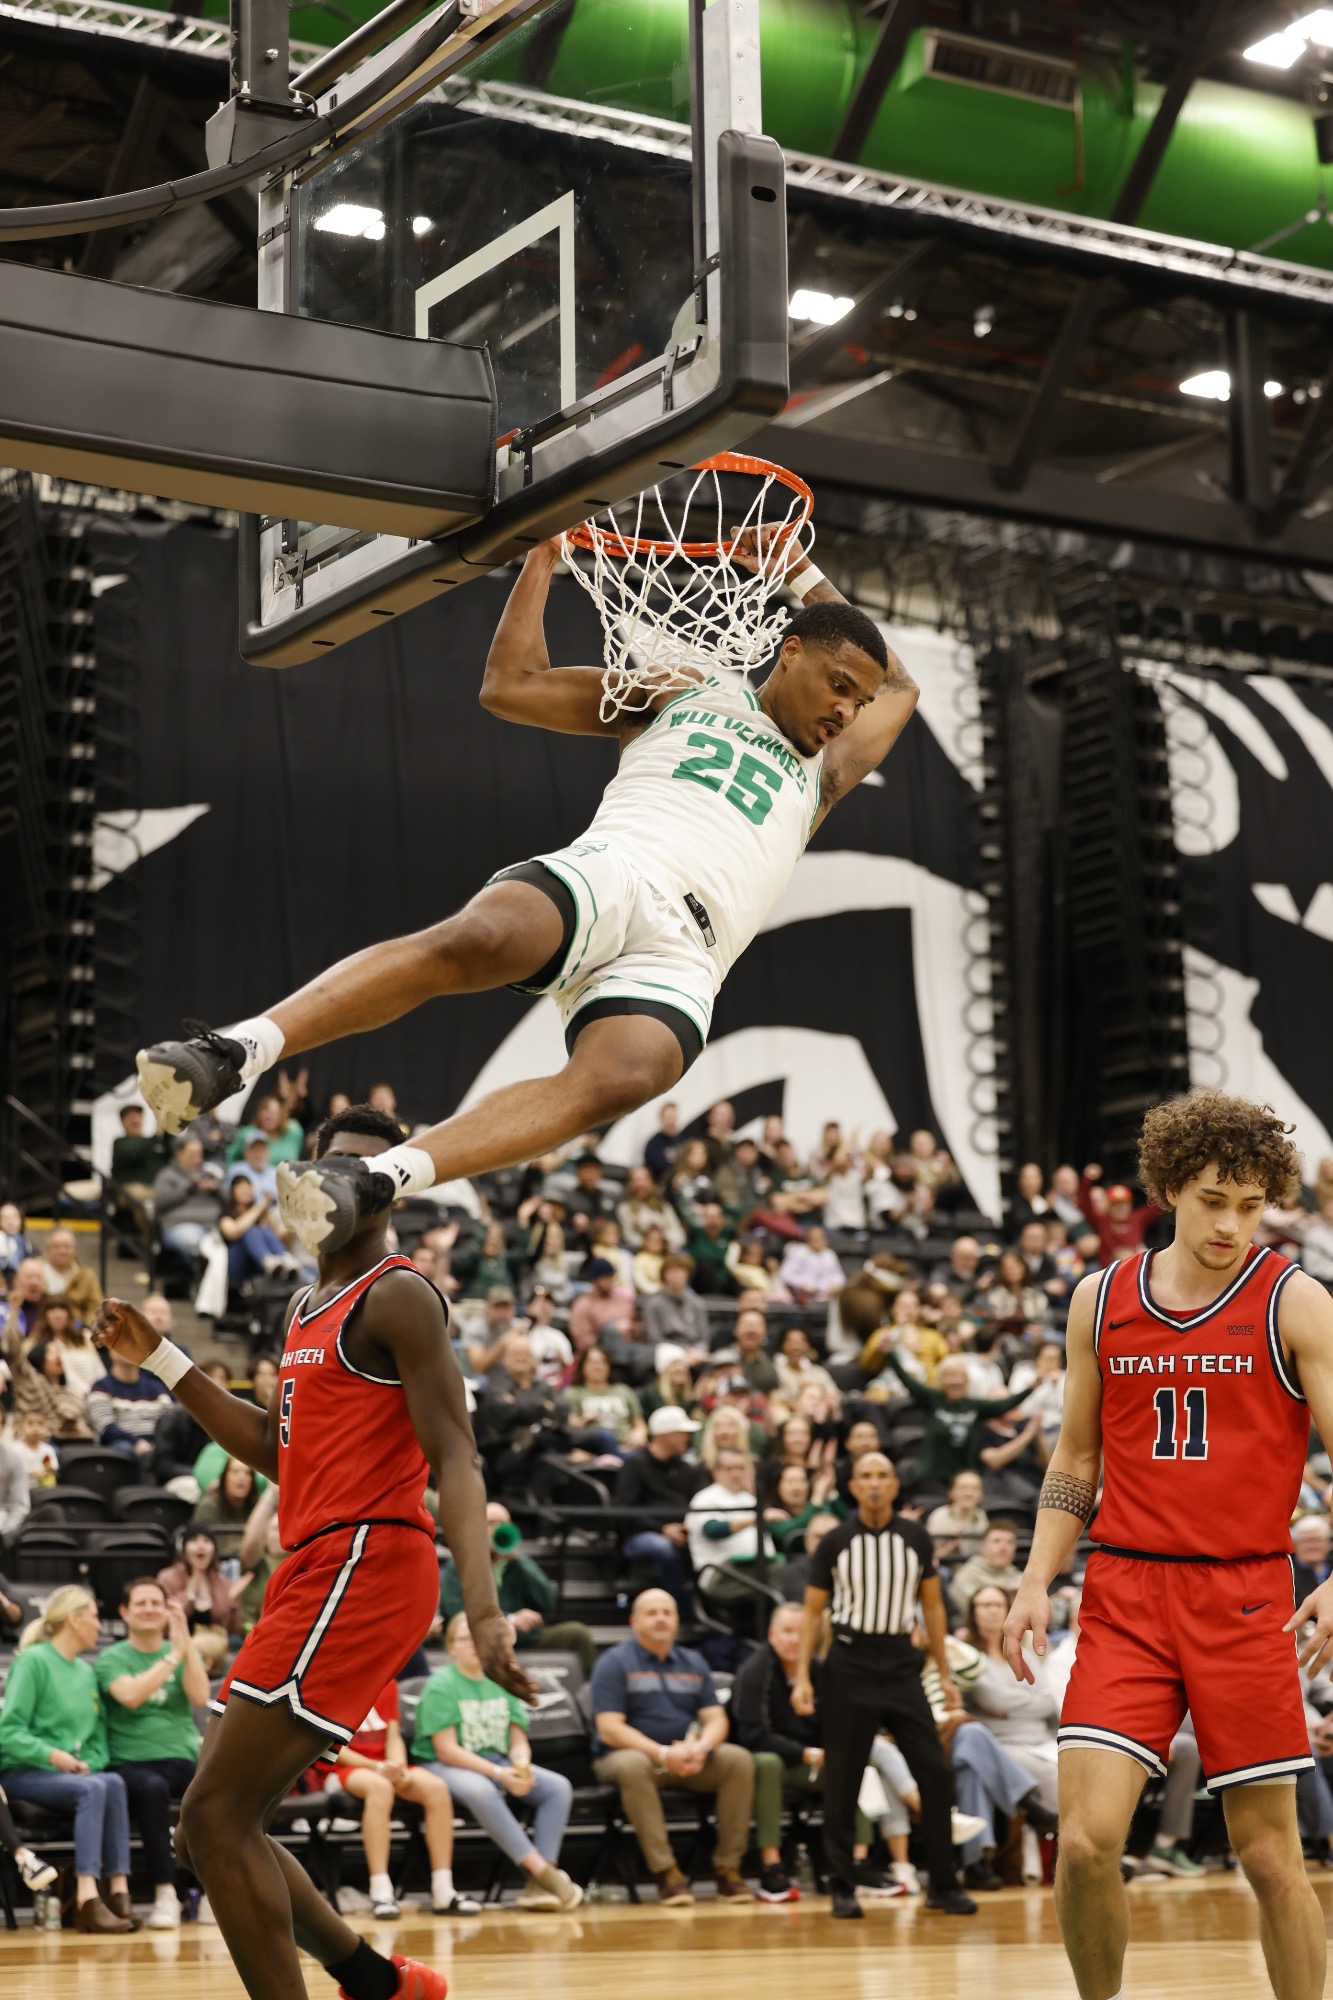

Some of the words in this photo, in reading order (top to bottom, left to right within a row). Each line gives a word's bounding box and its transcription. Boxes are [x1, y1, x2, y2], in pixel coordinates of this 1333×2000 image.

[669, 710, 808, 795] WOLVERINES
[671, 731, 784, 826] 25
[280, 1352, 294, 1368] AH
[294, 1348, 325, 1365] TECH
[1108, 1354, 1176, 1375] UTAH
[1181, 1354, 1254, 1375] TECH
[1227, 1325, 1254, 1335] WAC
[280, 1378, 295, 1448] 5
[1152, 1387, 1209, 1461] 11
